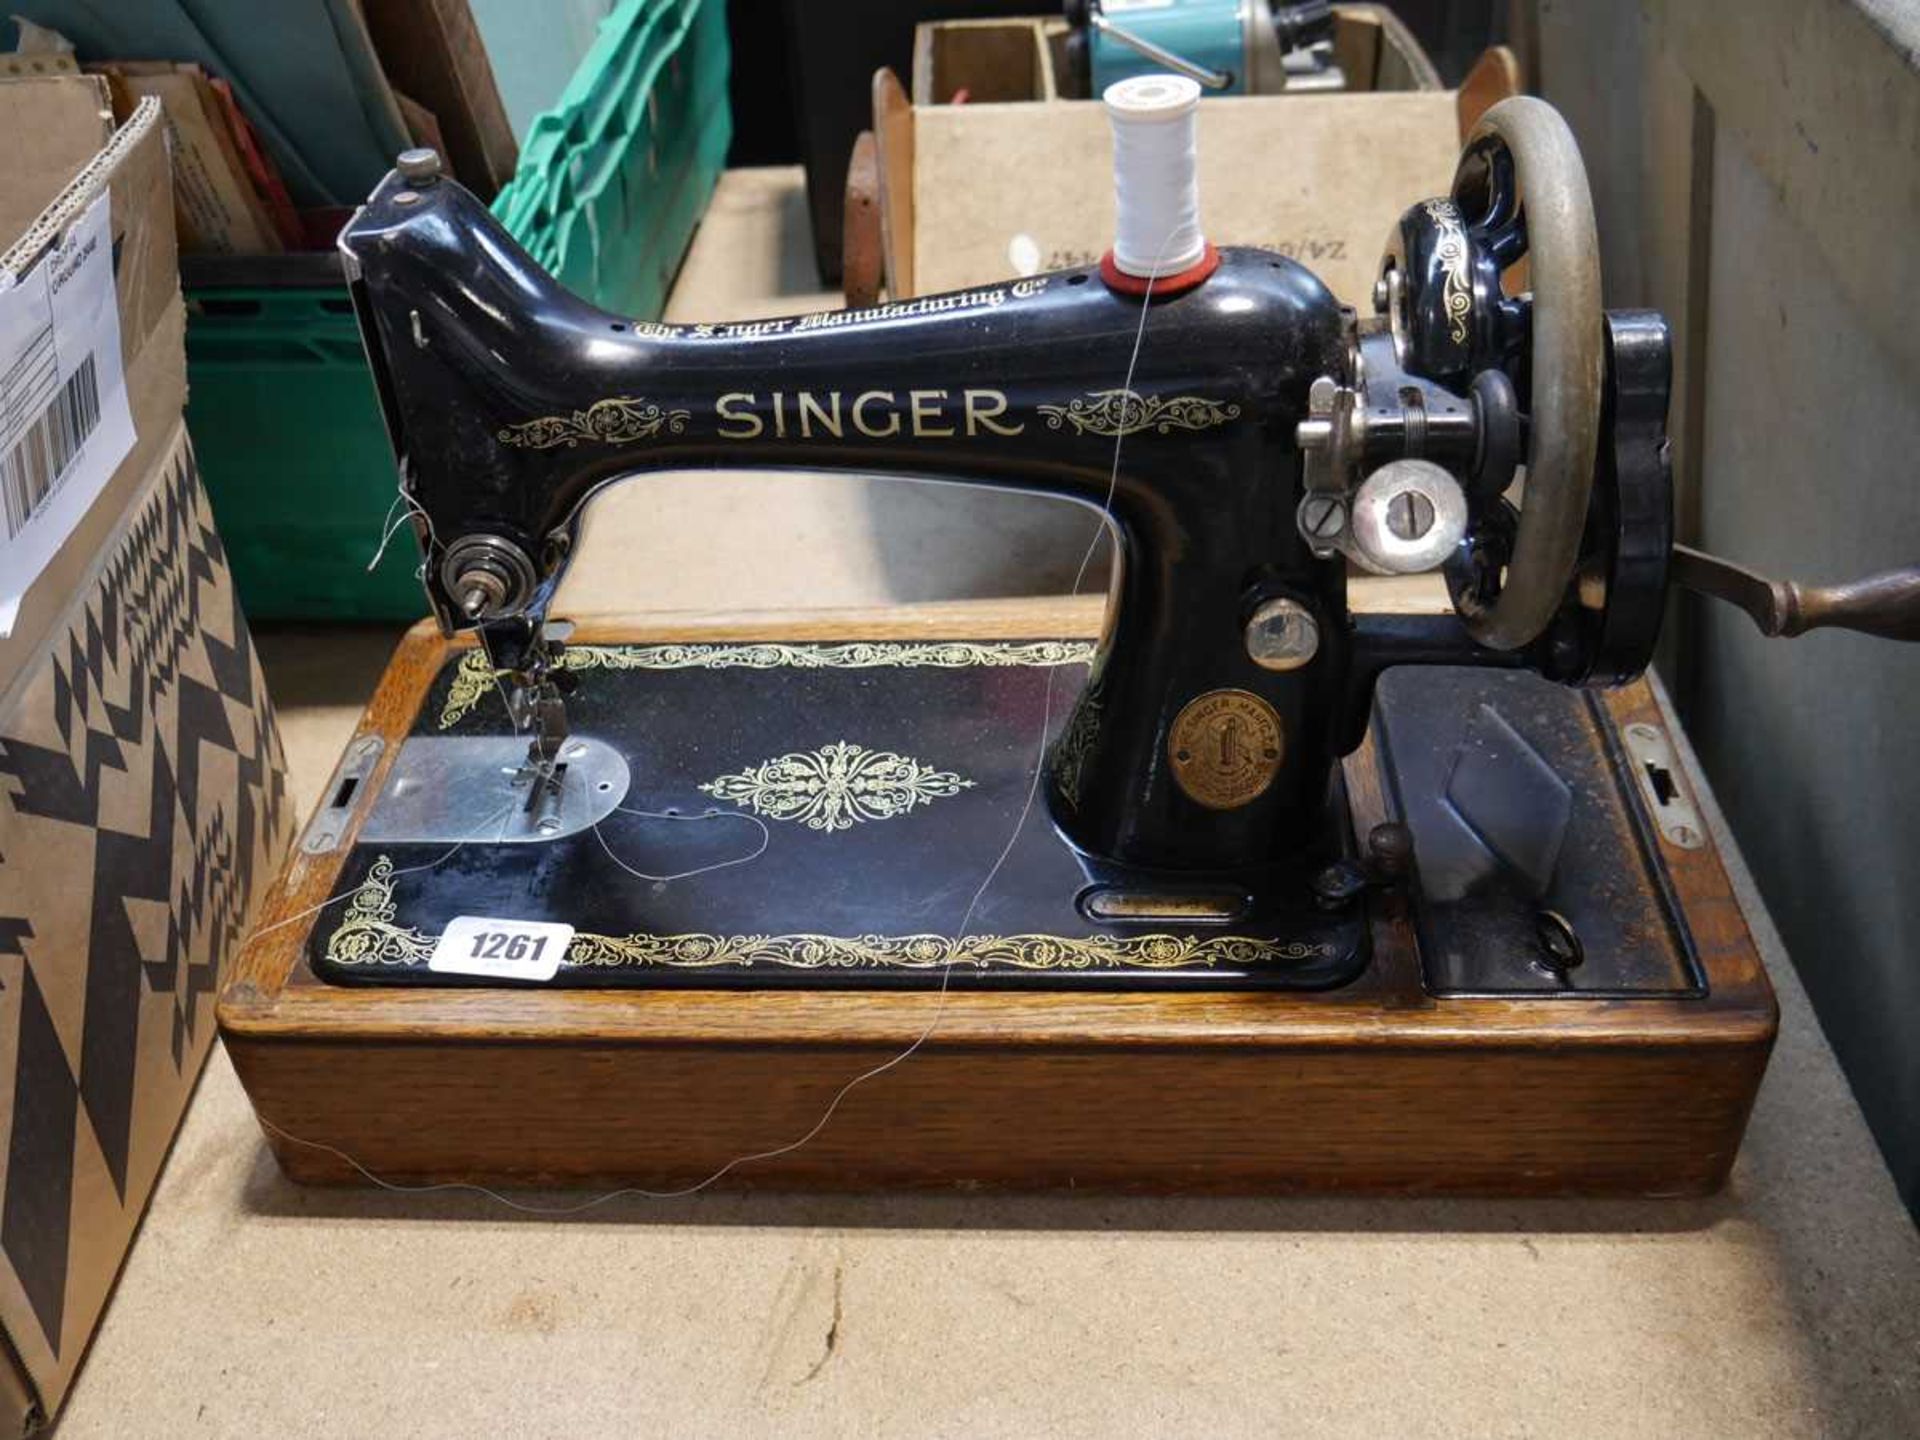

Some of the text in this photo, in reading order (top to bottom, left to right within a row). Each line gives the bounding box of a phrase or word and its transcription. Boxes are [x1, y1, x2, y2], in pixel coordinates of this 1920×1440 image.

[792, 285, 1006, 335] Manufacturing
[714, 388, 1026, 440] SINGER
[469, 932, 549, 961] 1261
